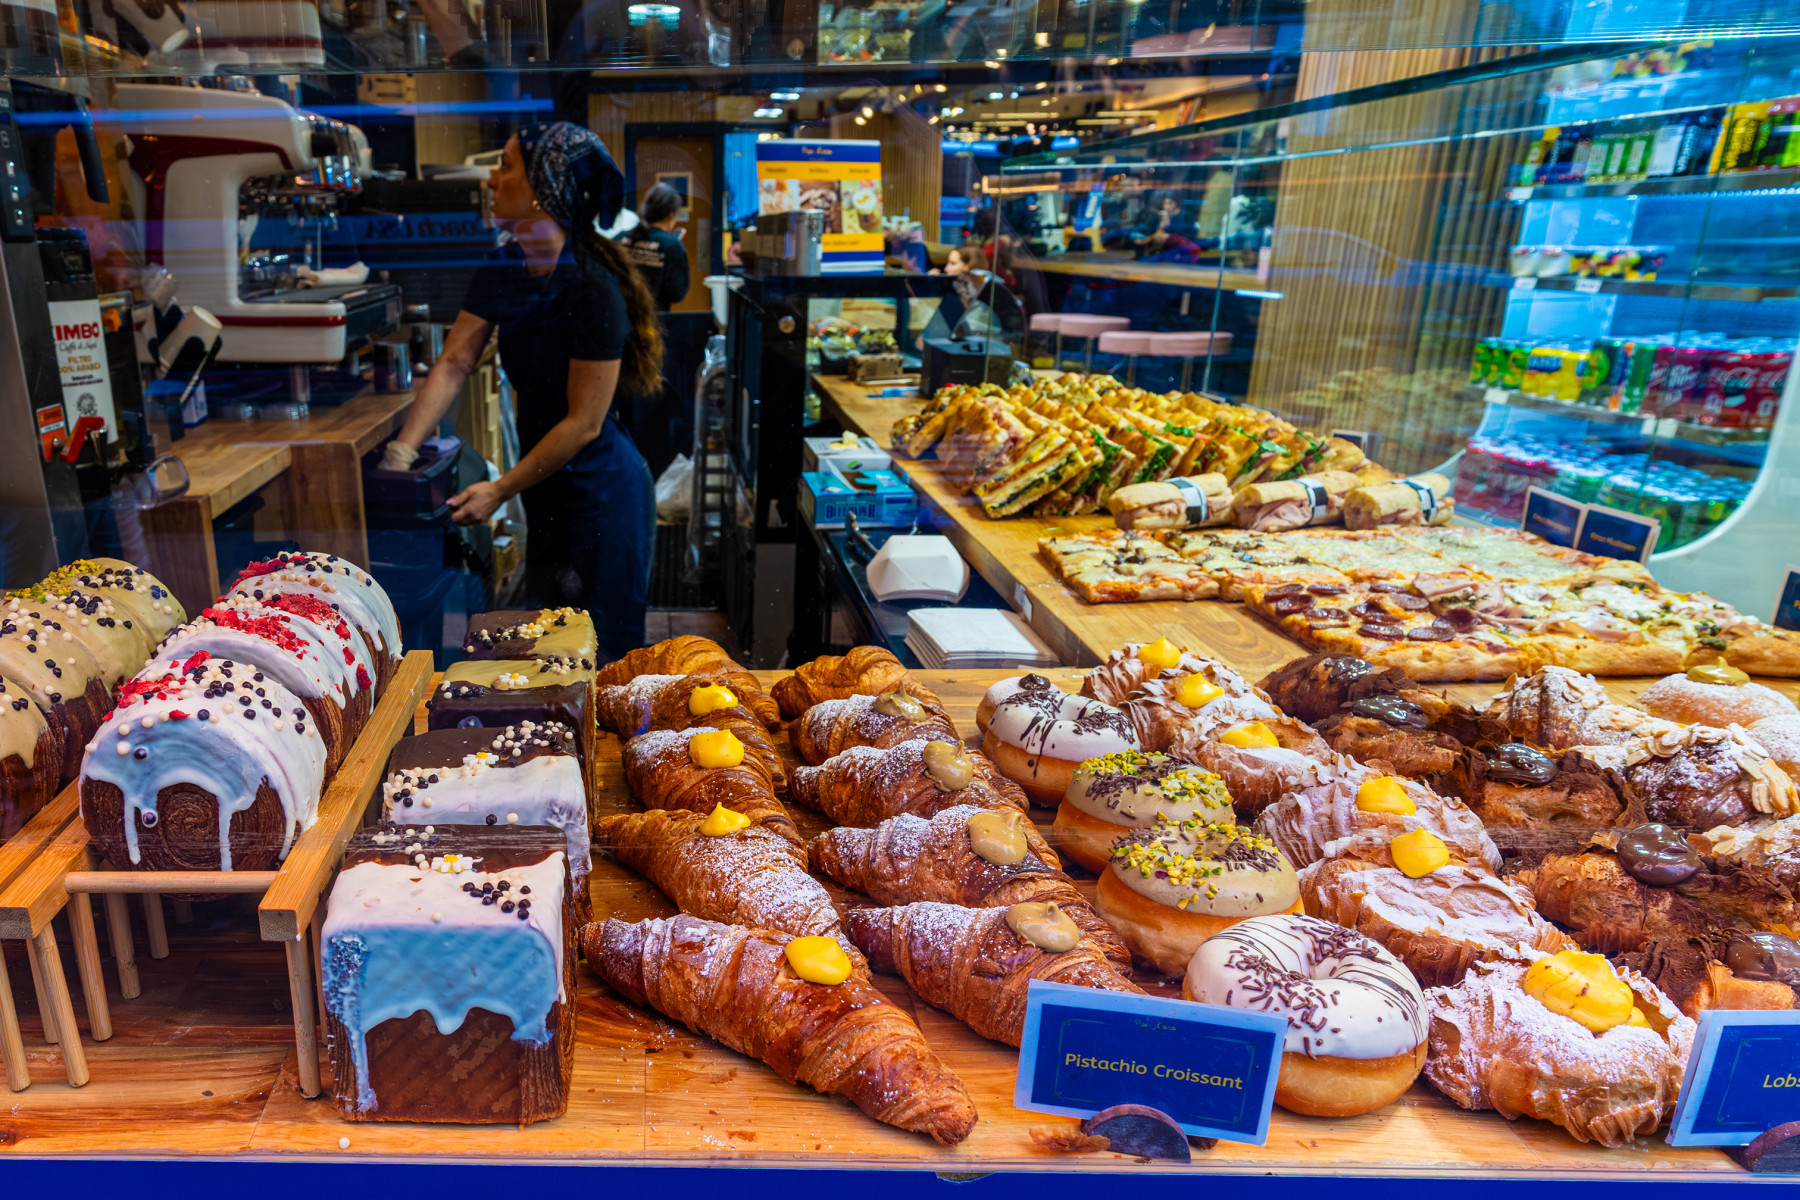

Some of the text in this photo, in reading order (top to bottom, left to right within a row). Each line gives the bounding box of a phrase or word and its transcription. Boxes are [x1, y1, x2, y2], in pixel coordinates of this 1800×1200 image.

[53, 322, 100, 341] IMBO
[1065, 1053, 1243, 1090] Pistachio Croissant
